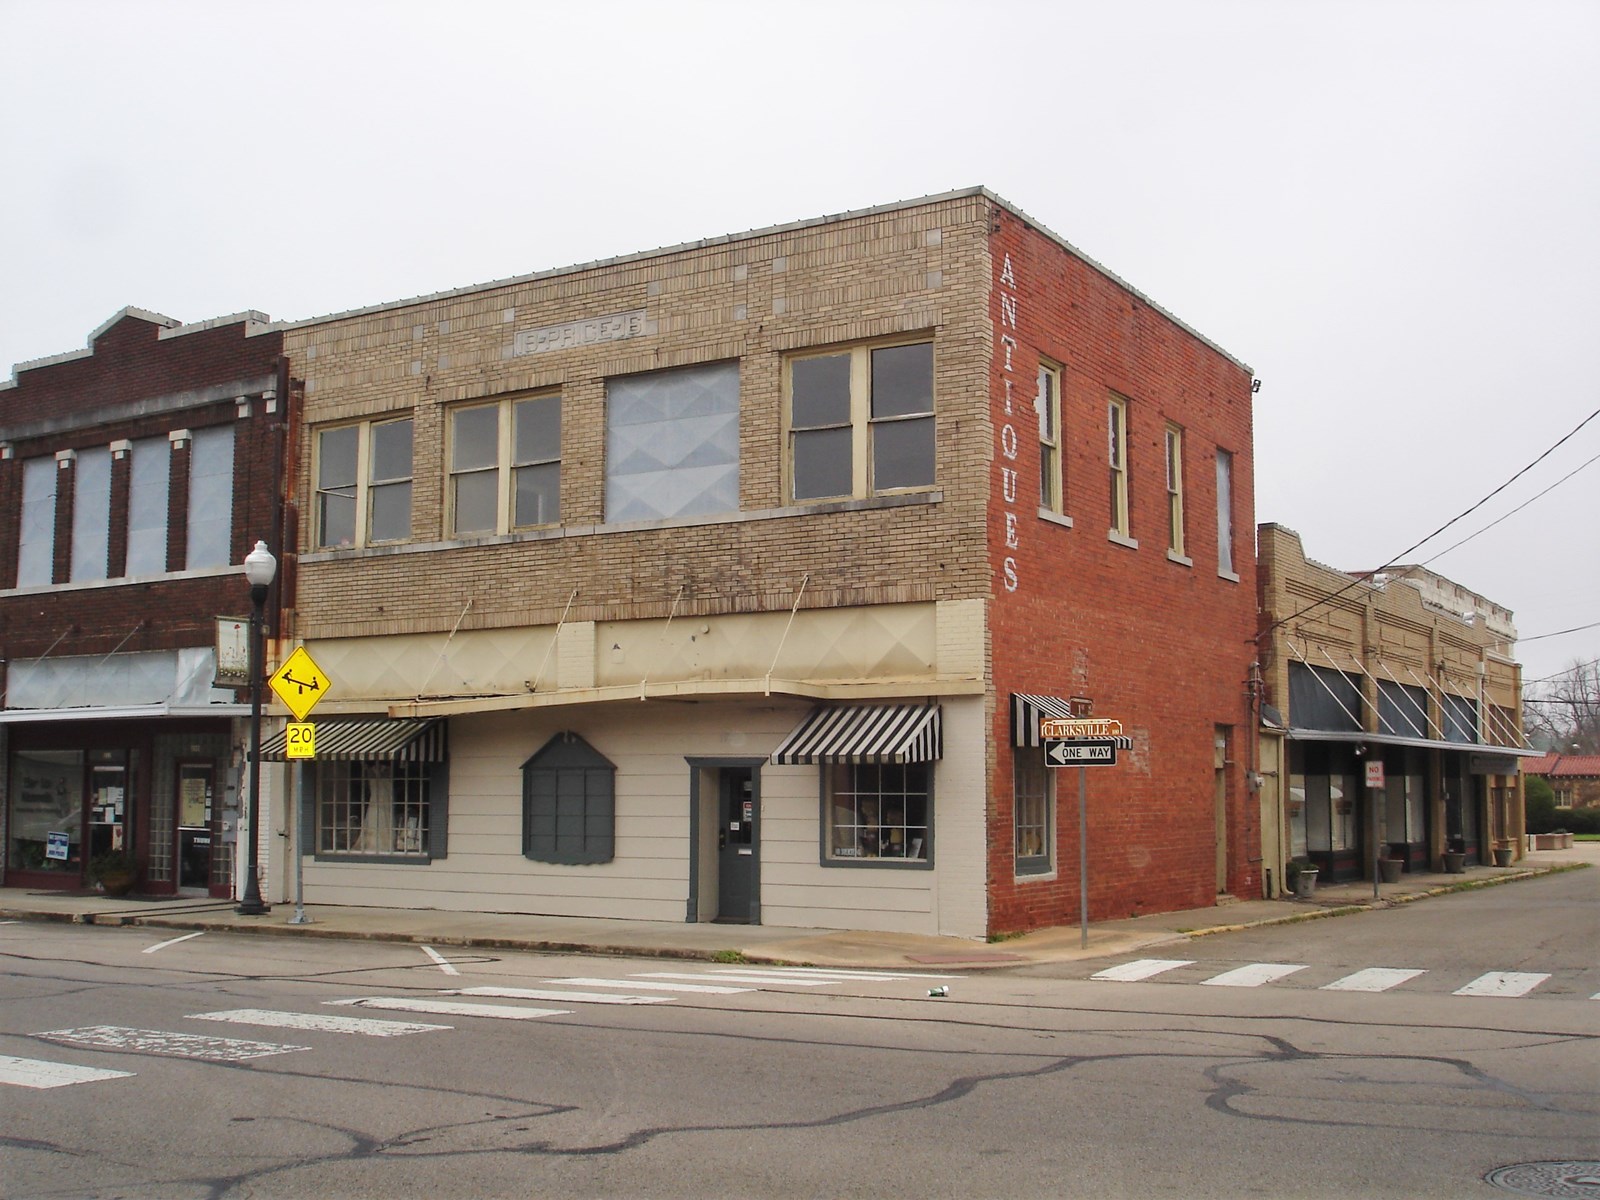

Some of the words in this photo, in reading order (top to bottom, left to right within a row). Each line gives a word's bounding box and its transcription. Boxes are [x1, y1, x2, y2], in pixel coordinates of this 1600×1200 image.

[1000, 252, 1019, 593] ANTIQUES
[290, 728, 311, 743] 20
[1044, 724, 1109, 736] CLARKSVILLE
[1062, 747, 1082, 758] ONE
[1089, 747, 1110, 758] WAY
